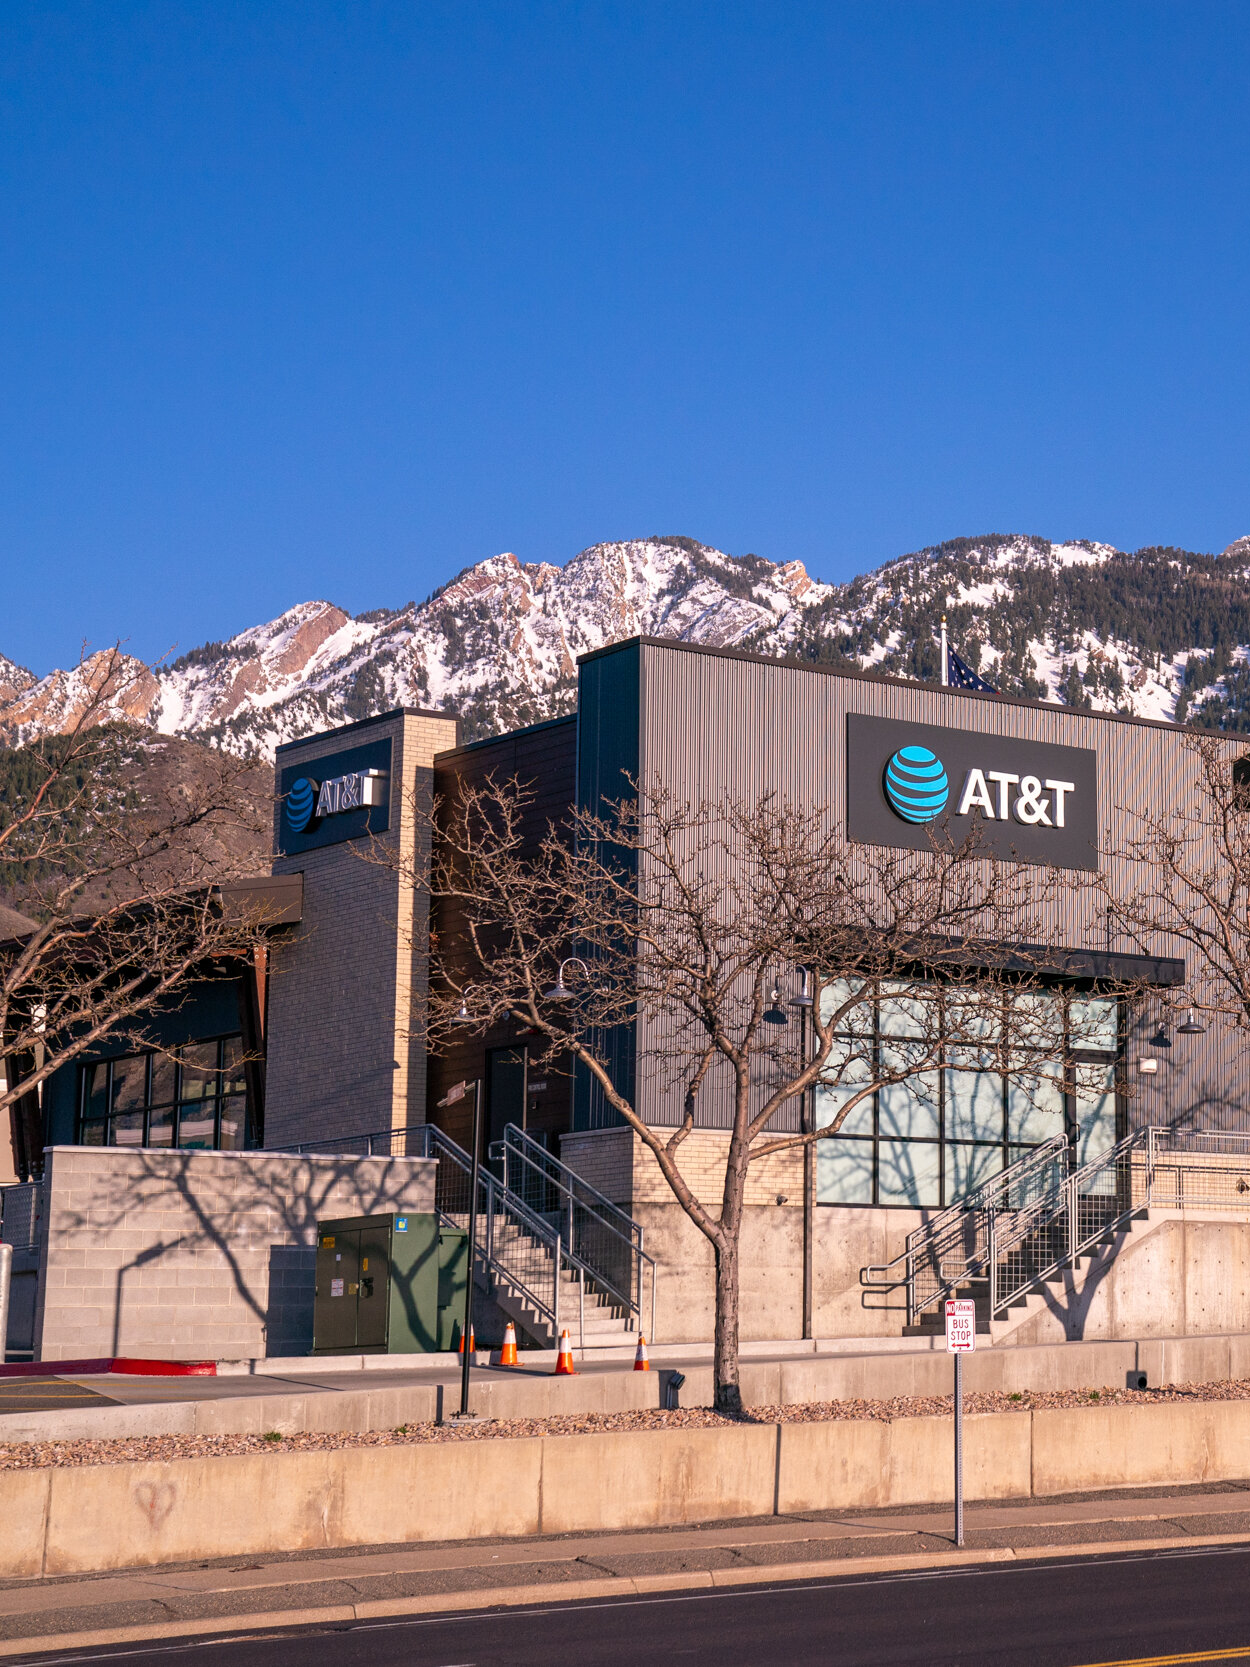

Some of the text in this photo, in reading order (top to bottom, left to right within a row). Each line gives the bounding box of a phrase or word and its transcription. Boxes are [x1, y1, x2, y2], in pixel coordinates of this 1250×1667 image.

[315, 768, 379, 817] AT&T
[955, 768, 1075, 828] AT&T
[946, 1303, 955, 1314] NO
[953, 1319, 969, 1329] BUS
[950, 1330, 971, 1341] STOP
